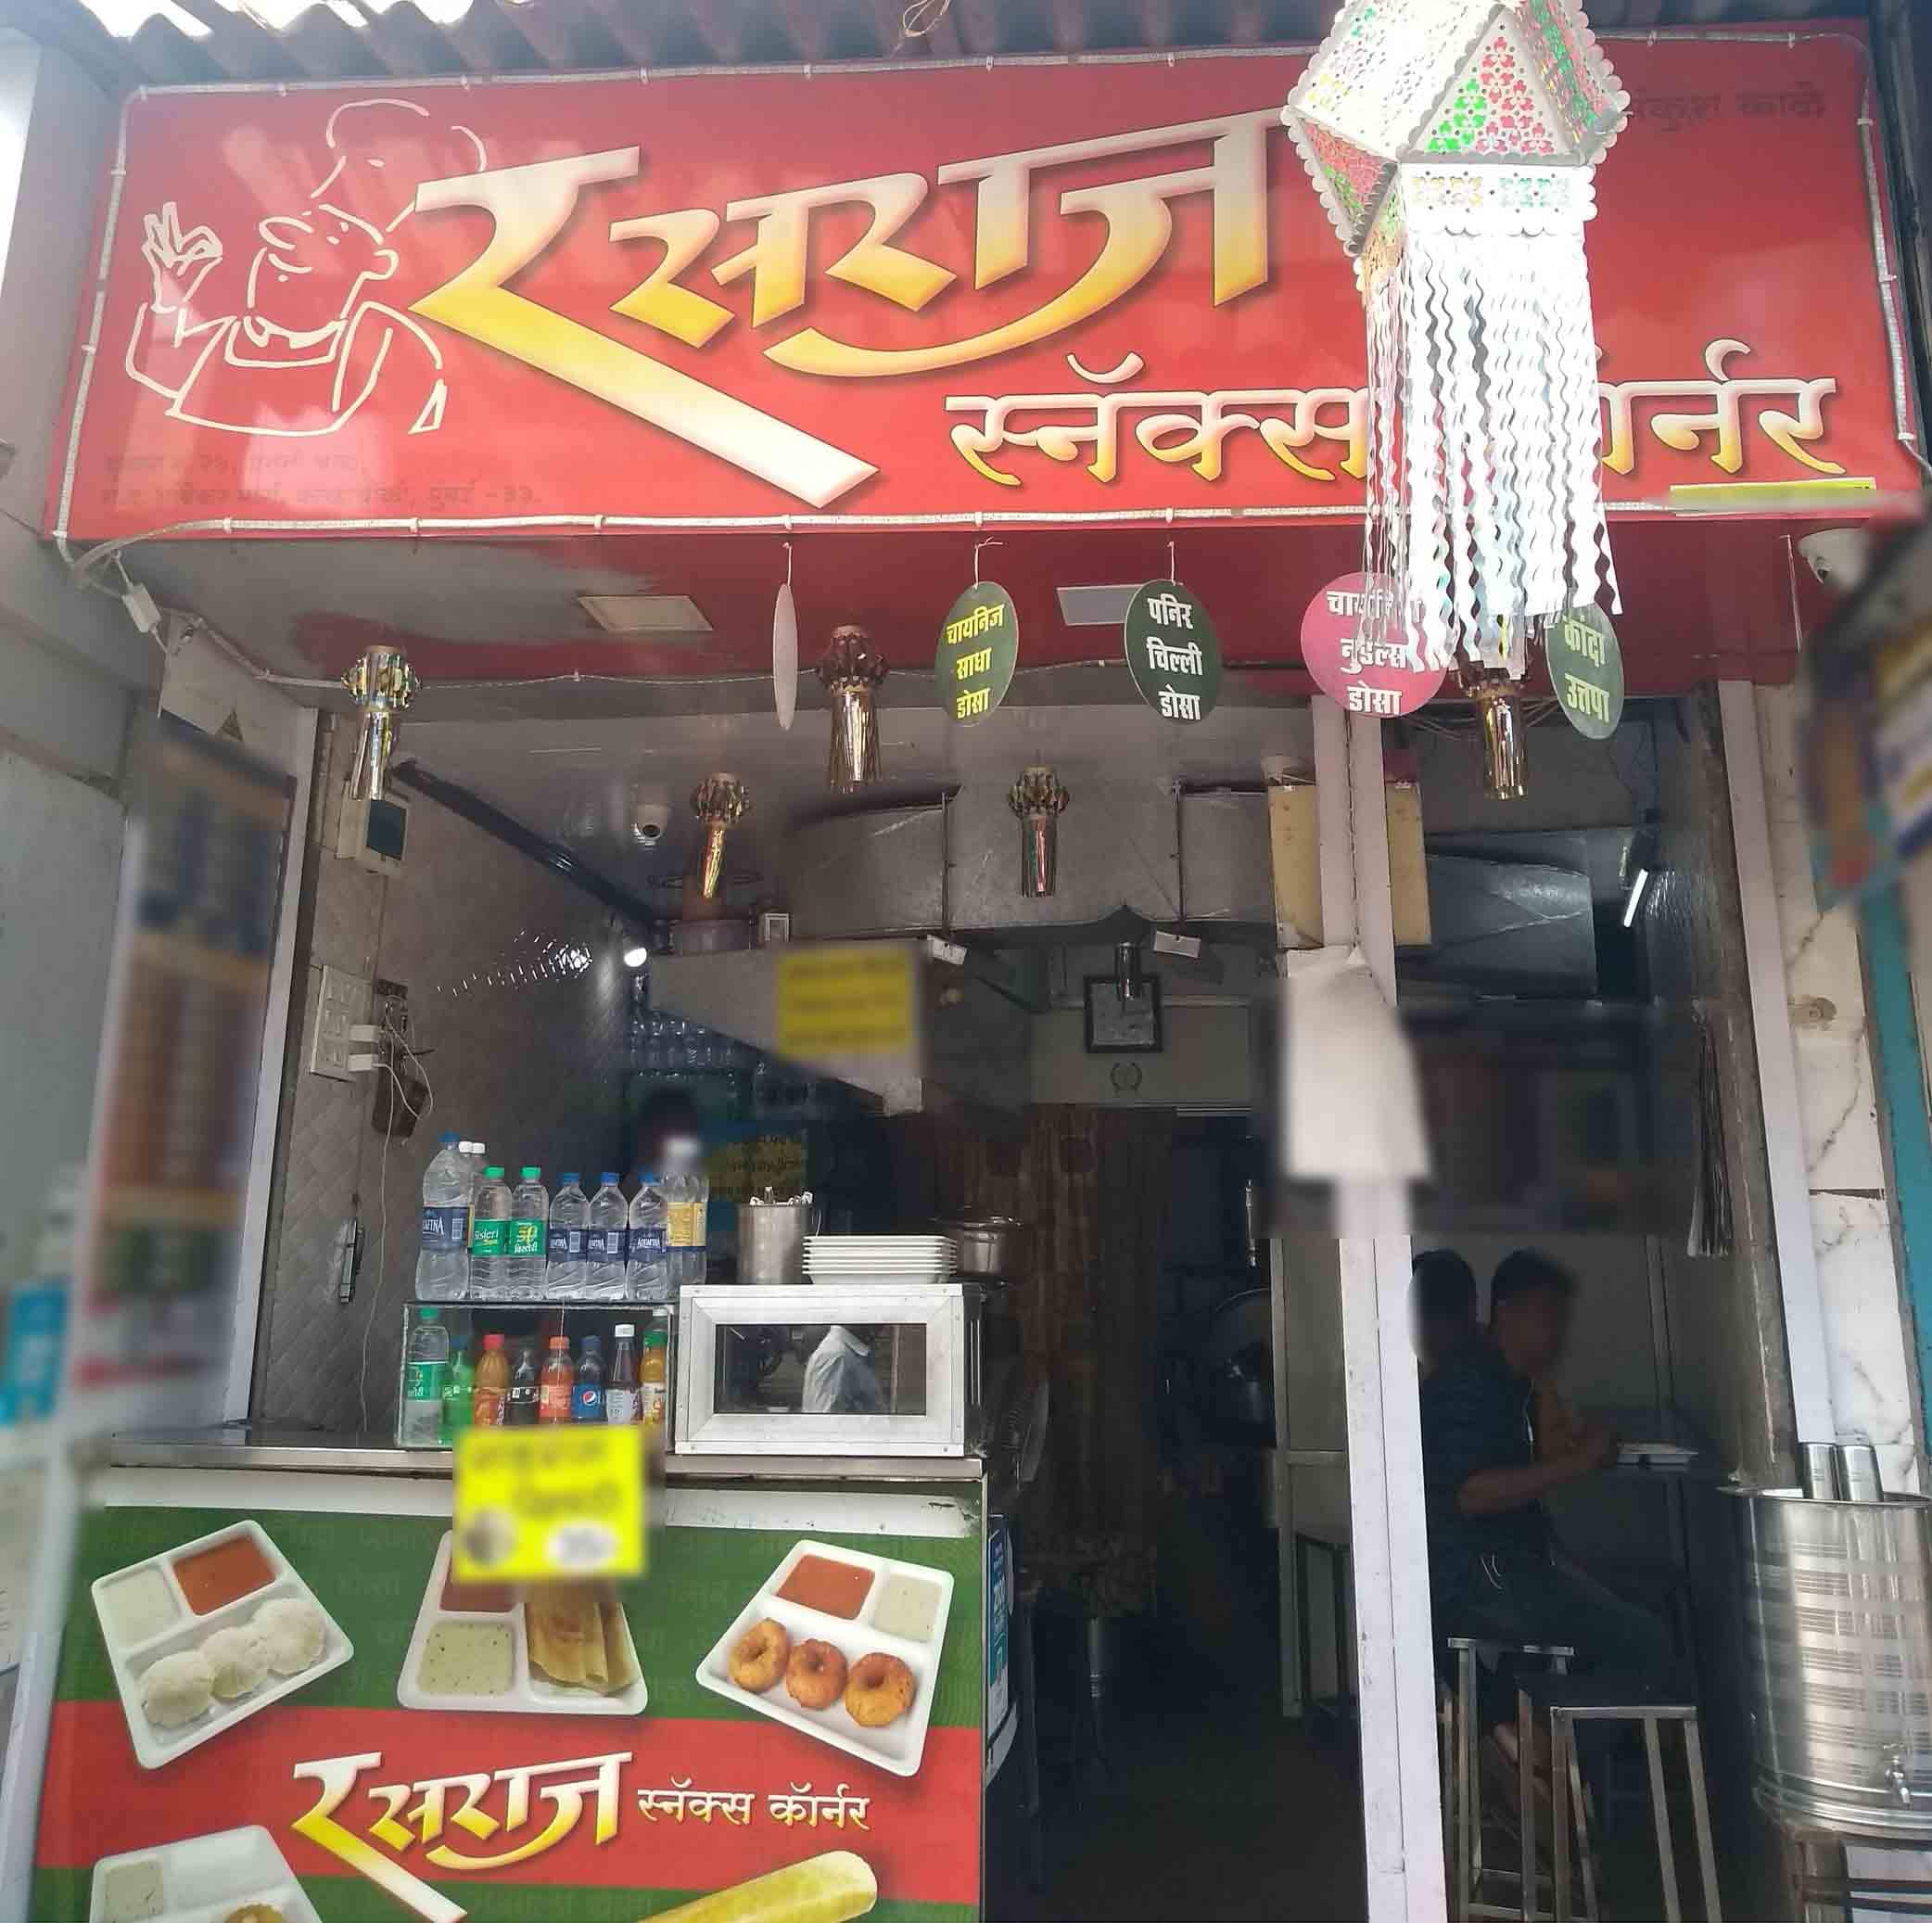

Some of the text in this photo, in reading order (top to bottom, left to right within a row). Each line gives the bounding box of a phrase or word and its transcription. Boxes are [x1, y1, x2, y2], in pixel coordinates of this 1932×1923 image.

[408, 106, 1285, 510] रसराज
[944, 351, 1372, 488] स्नॅक्स
[946, 603, 1006, 646] चायनिज
[1147, 592, 1195, 630] पनिर
[956, 647, 993, 681] साधा
[1145, 636, 1204, 676] चिल्ली
[956, 686, 991, 720] डोसा
[1158, 683, 1201, 721] डोसा
[1347, 681, 1403, 716] डोसा
[291, 1751, 633, 1922] रसराज
[637, 1776, 756, 1825] स्नॅक्स
[768, 1780, 871, 1830] कॉर्नर
